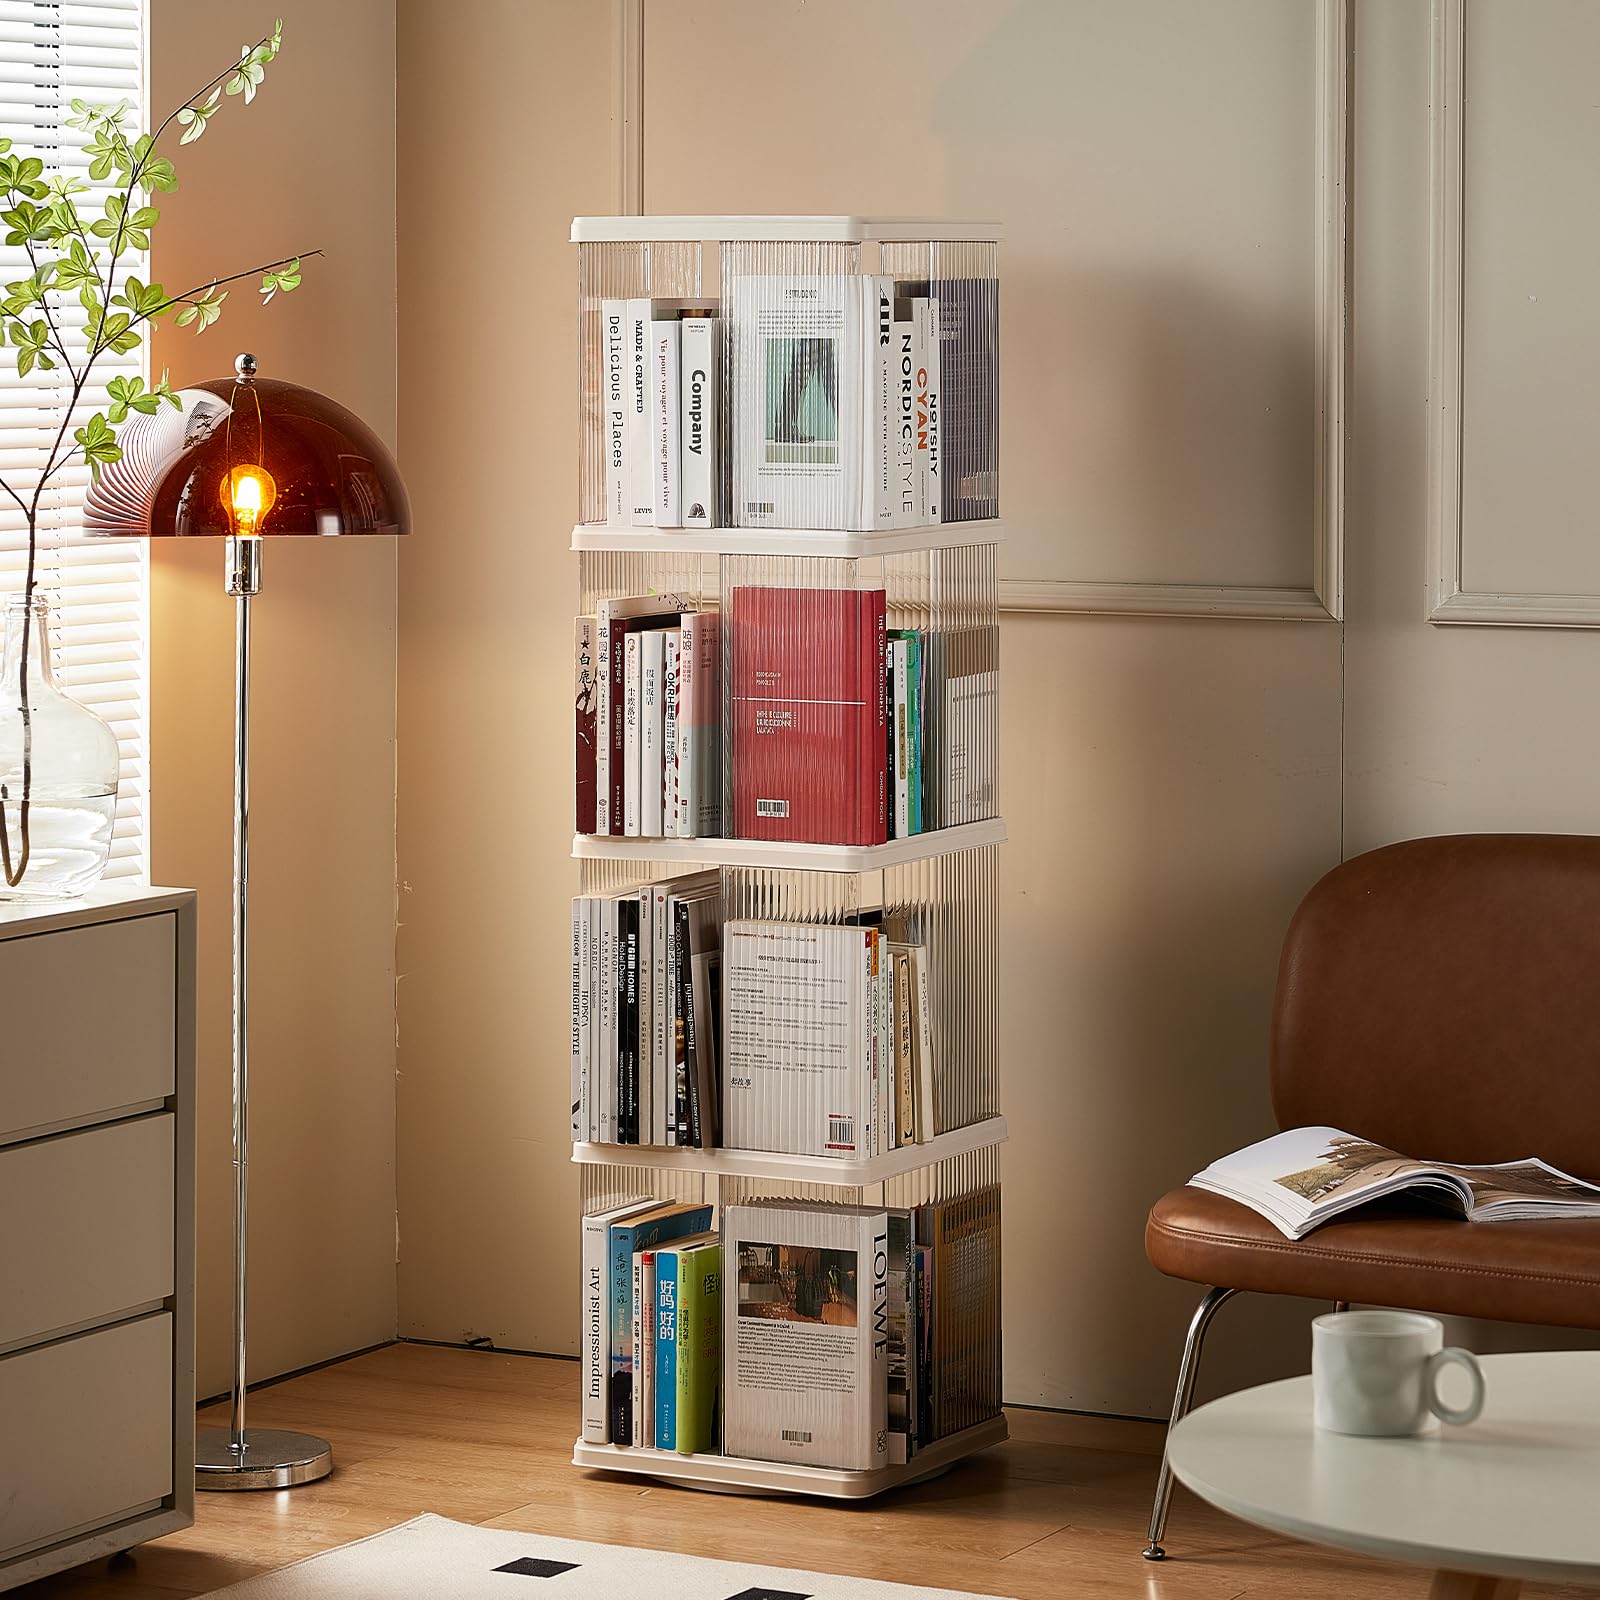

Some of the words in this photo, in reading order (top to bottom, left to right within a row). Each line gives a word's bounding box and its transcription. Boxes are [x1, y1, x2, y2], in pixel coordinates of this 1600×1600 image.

[880, 284, 891, 348] AIR
[635, 320, 643, 352] MADE
[660, 338, 668, 352] Vis
[609, 316, 622, 401] Delicious
[635, 354, 643, 363] &
[659, 356, 667, 376] pour
[635, 365, 643, 413] CRAFTED
[660, 380, 668, 415] voyager
[661, 417, 668, 426] et
[689, 370, 706, 455] Company
[917, 367, 928, 450] CYAN
[611, 411, 623, 469] Places
[618, 964, 626, 992] Design
[573, 1018, 580, 1026] of
[581, 990, 589, 1028] HOPSCA
[590, 1267, 601, 1291] Art
[873, 1232, 888, 1360] LOEWE
[589, 1294, 601, 1400] Impressionist
